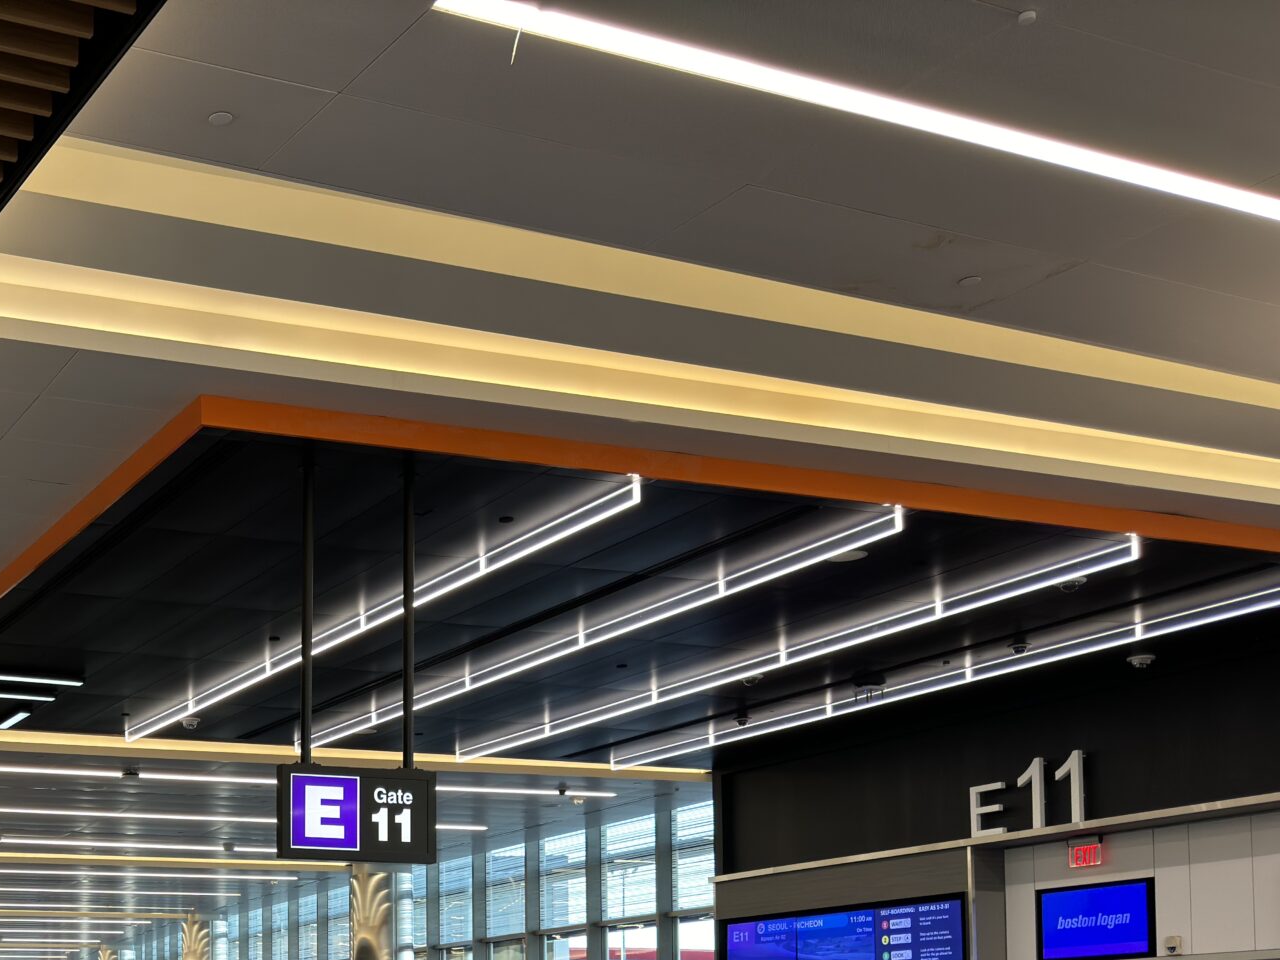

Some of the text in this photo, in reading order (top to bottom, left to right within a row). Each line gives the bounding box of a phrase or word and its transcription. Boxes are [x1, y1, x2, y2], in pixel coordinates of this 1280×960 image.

[373, 787, 414, 805] Gate
[969, 749, 1086, 839] E11
[304, 784, 345, 840] E
[371, 807, 412, 843] 11
[1074, 844, 1099, 867] EXIT
[767, 922, 789, 932] SEOUL
[850, 915, 866, 923] 11:00
[1057, 912, 1131, 930] boston logan
[732, 931, 749, 943] E11
